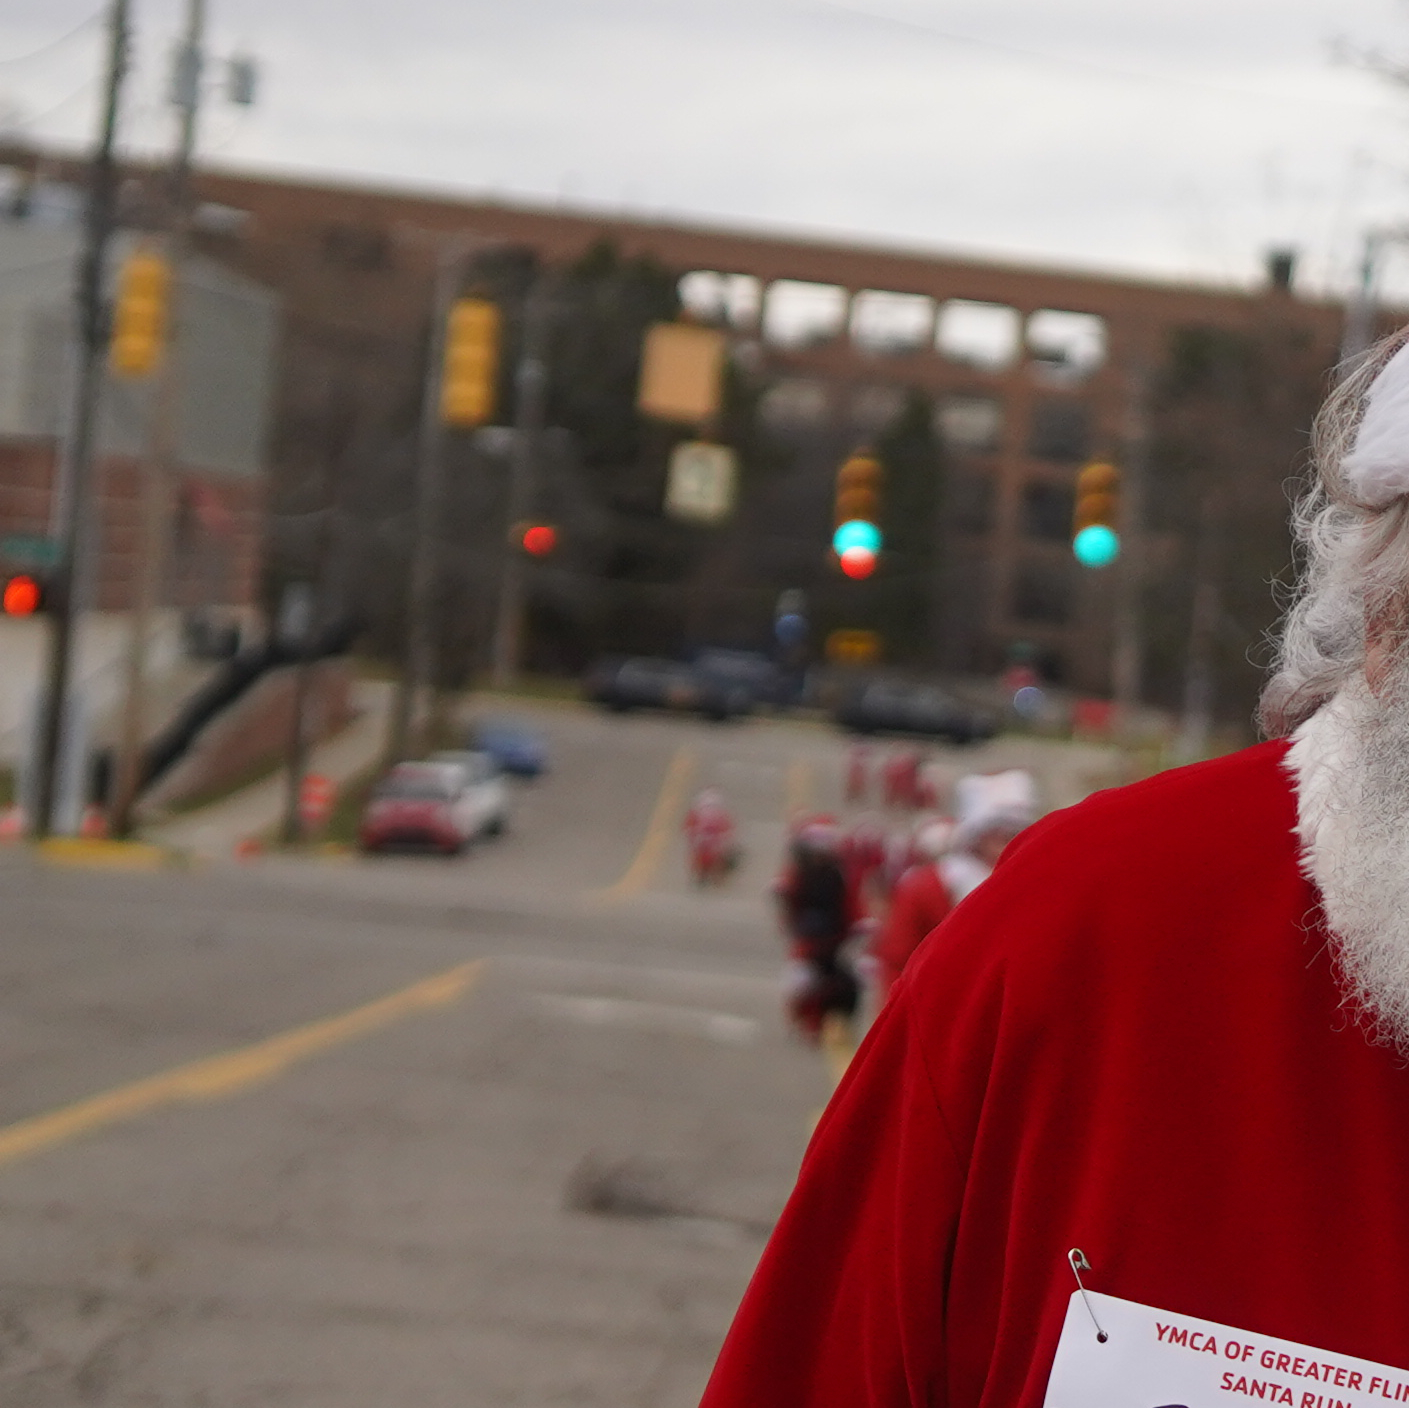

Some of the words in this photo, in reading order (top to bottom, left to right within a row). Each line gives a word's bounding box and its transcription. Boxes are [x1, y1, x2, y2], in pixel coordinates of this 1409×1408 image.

[1155, 1322, 1218, 1355] YMCA
[1224, 1341, 1255, 1363] OF
[1260, 1350, 1363, 1391] GREATER
[1220, 1372, 1293, 1407] SANTA
